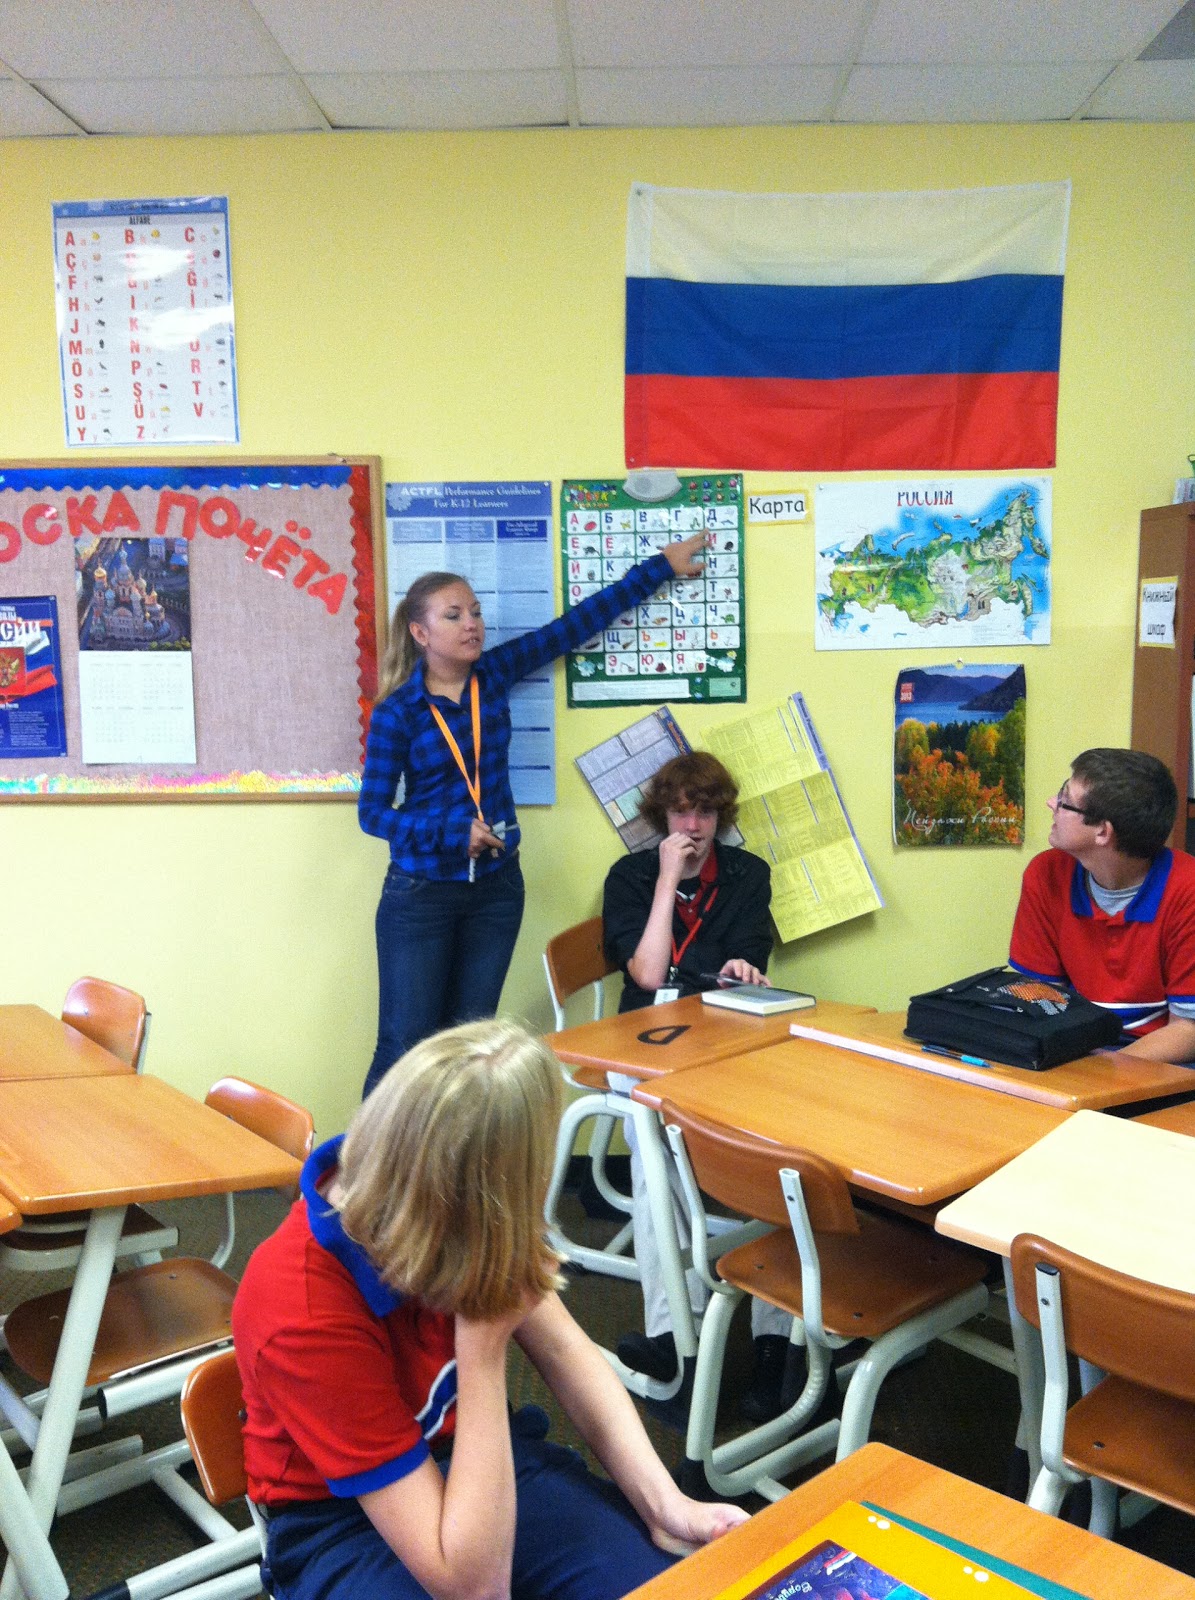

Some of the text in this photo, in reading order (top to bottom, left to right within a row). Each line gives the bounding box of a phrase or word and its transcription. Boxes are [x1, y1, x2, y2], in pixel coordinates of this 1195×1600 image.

[65, 231, 75, 246] A
[124, 229, 135, 244] B
[184, 226, 195, 243] C
[68, 275, 77, 290] F
[68, 297, 79, 312] H
[70, 319, 79, 334] J
[69, 340, 82, 355] M
[131, 360, 141, 375] P
[191, 358, 201, 374] R
[74, 384, 83, 399] S
[192, 381, 201, 396] T
[75, 405, 85, 420] U
[193, 402, 203, 417] V
[77, 427, 86, 441] Y
[136, 425, 145, 439] Z
[400, 485, 542, 496] ACTFL Performance Guidelines
[433, 499, 509, 509] For K-12 Learners
[749, 497, 805, 519] Карта
[570, 509, 717, 525] А Б В Г Д
[571, 537, 579, 549] Е
[639, 535, 651, 547] Ж
[155, 490, 348, 616] ПОЧЁТА
[606, 560, 614, 572] К
[709, 557, 717, 568] Н
[572, 585, 581, 596] О
[710, 581, 717, 592] Т
[641, 607, 650, 618] Х
[709, 605, 717, 616] Ч
[675, 629, 685, 640] Ы
[608, 653, 684, 666] Э Ю Я
